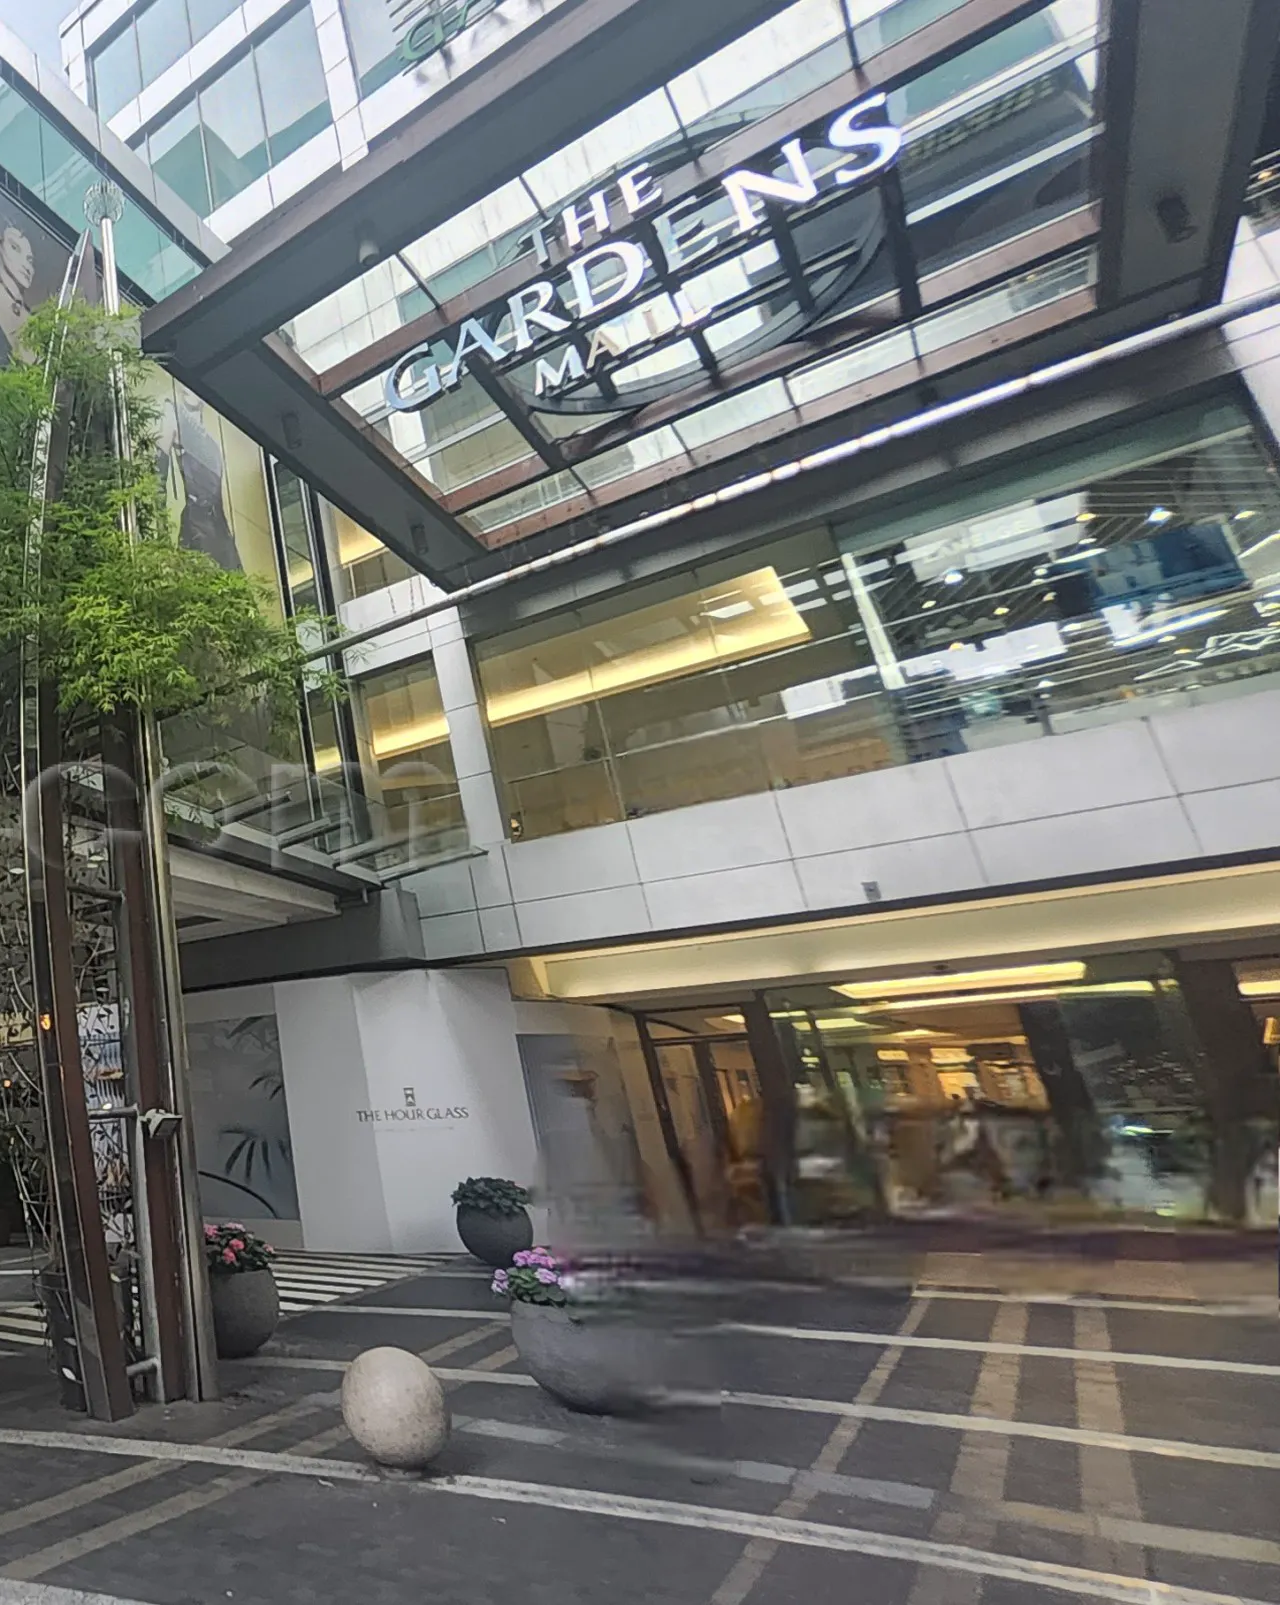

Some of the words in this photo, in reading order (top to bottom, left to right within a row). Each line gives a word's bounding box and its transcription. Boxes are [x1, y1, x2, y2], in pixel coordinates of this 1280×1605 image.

[384, 91, 904, 413] GARDENS
[518, 161, 664, 266] THE
[533, 279, 713, 397] MALL
[356, 1109, 382, 1122] THE
[384, 1108, 425, 1121] HOUR
[426, 1106, 469, 1120] GLASS
